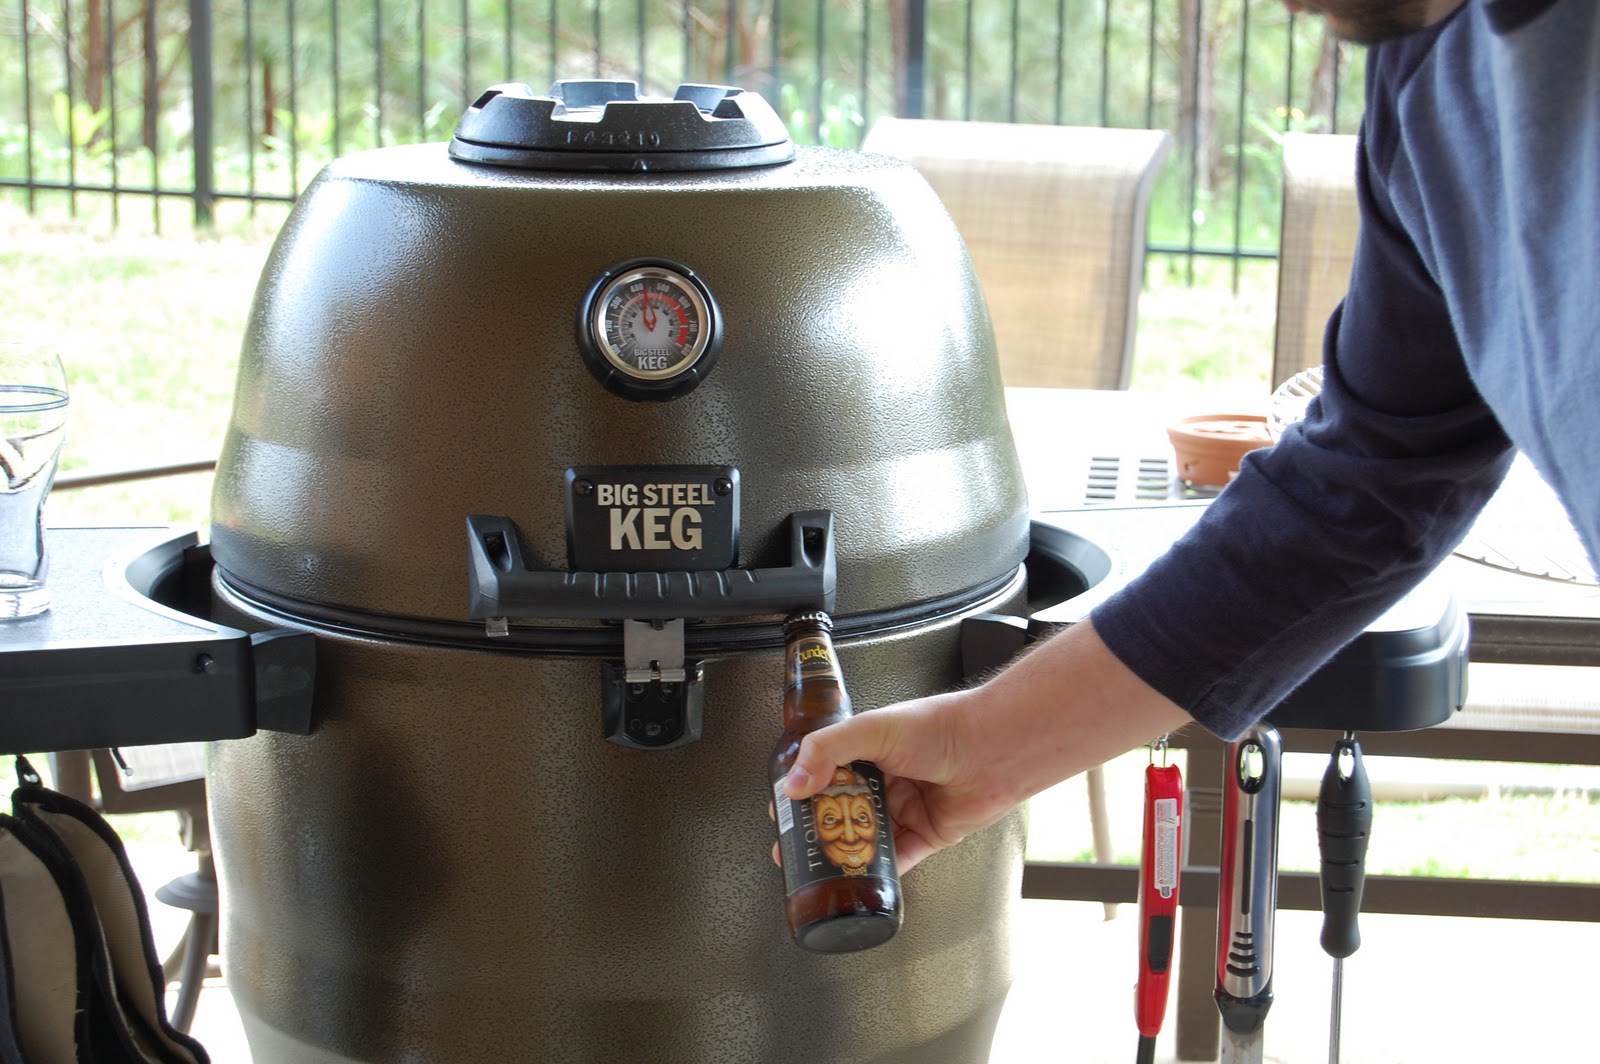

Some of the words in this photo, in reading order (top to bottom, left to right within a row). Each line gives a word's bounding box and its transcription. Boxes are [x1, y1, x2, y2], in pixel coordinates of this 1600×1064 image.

[630, 283, 644, 293] 400
[610, 296, 622, 310] 300
[648, 348, 671, 356] STEEL
[638, 356, 668, 370] KEG
[597, 484, 638, 506] BIG
[643, 483, 715, 506] STEEL
[610, 507, 703, 550] KEG
[800, 800, 823, 872] TROUB
